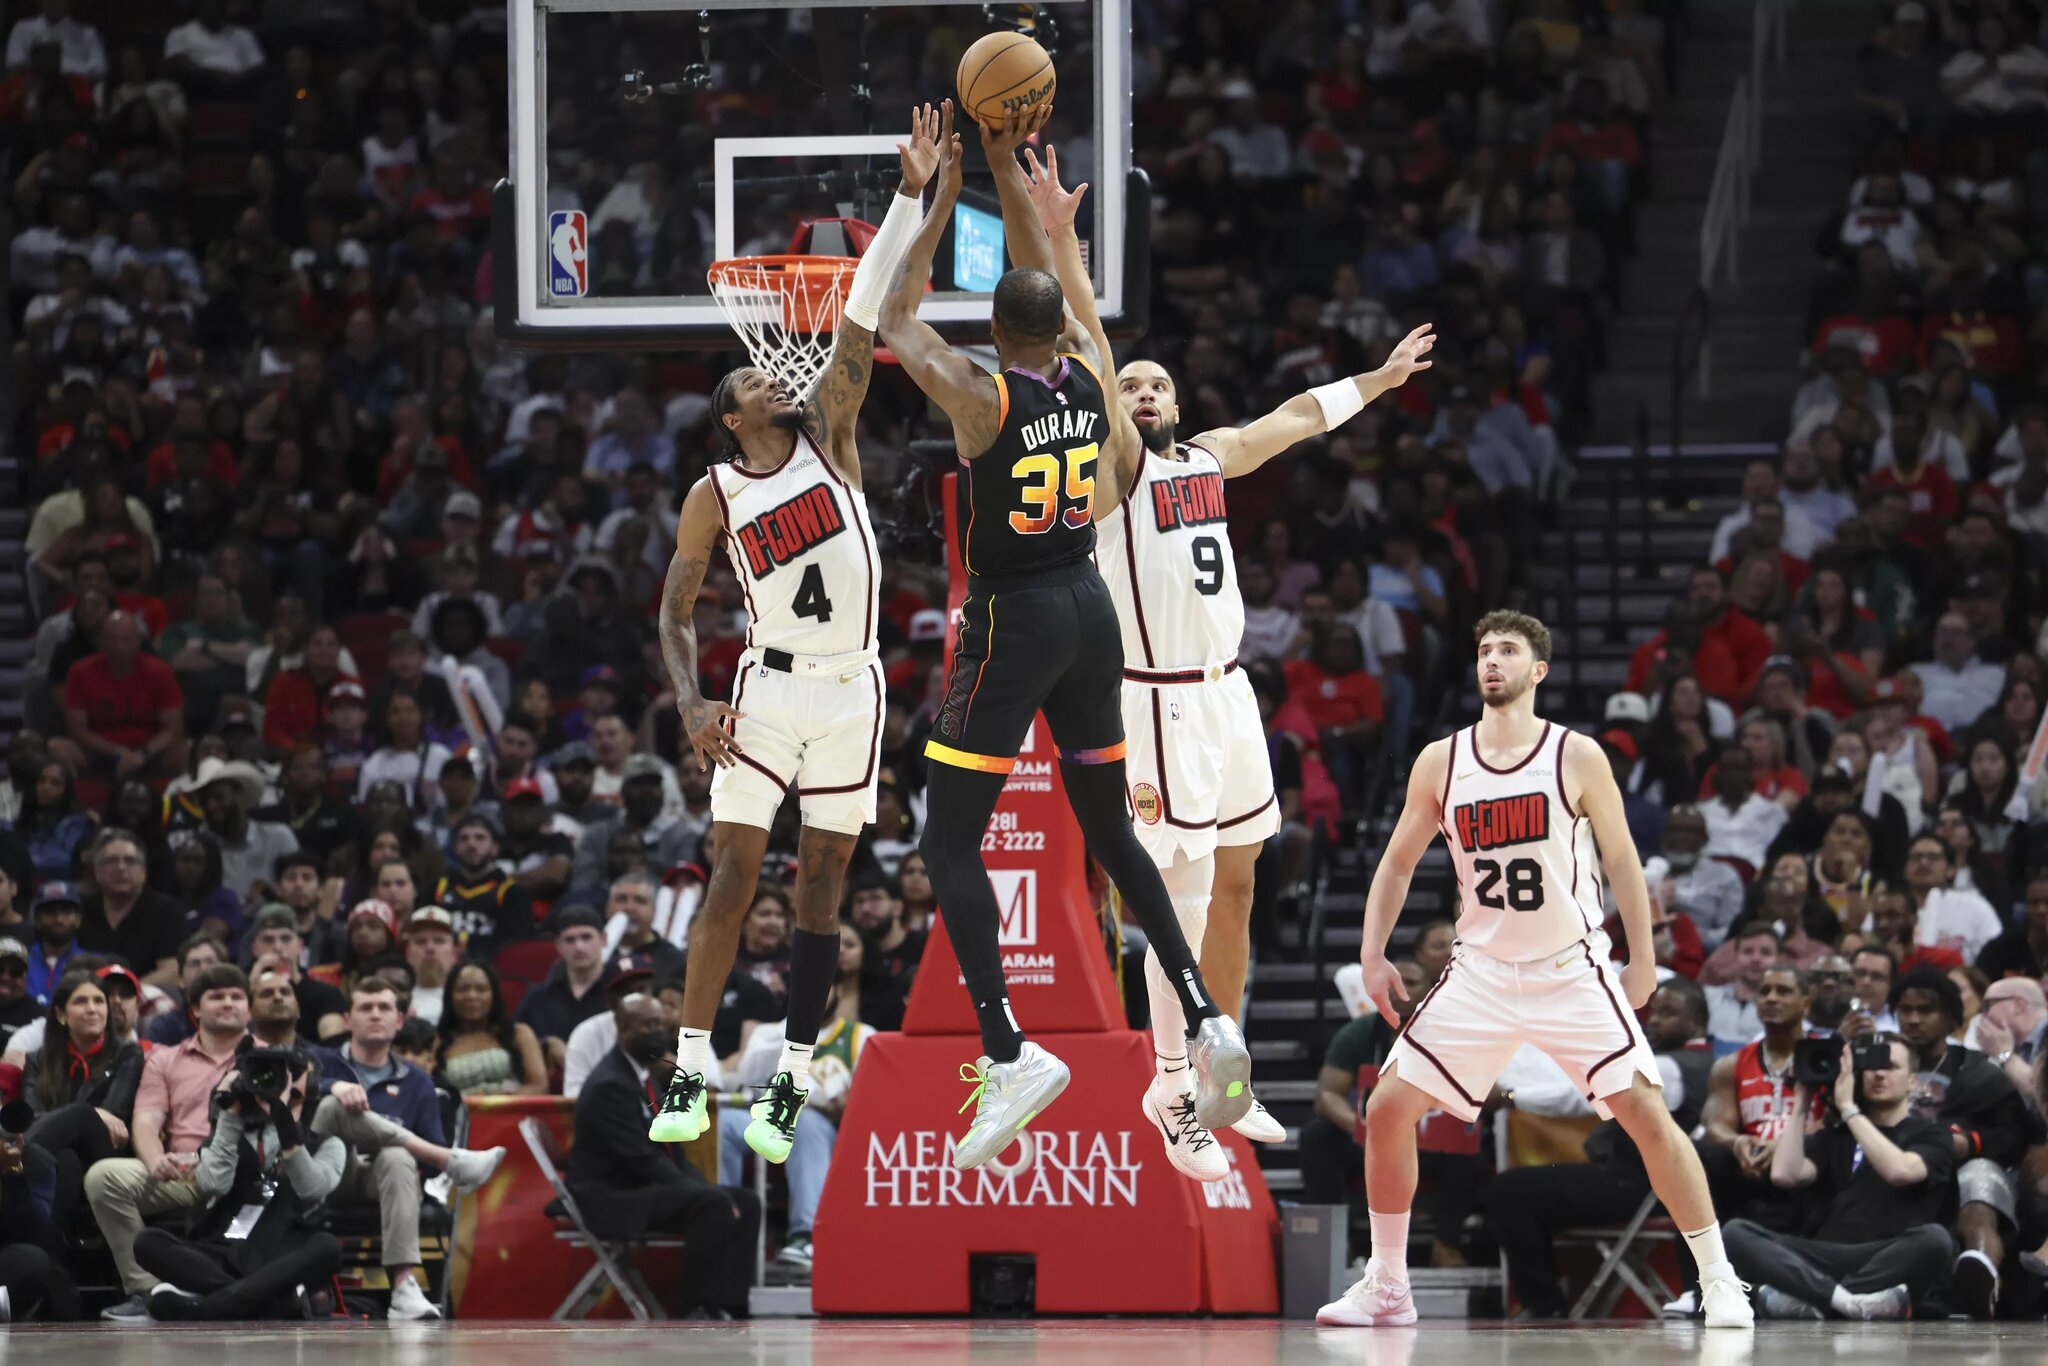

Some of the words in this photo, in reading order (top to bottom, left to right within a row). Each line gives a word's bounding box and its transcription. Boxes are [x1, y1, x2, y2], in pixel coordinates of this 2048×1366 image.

[1001, 77, 1054, 112] Wilson
[555, 278, 574, 292] NBA
[1020, 409, 1099, 452] DURANT
[1008, 441, 1099, 535] 35
[1191, 536, 1224, 595] 9
[791, 562, 833, 624] 4
[1474, 858, 1545, 912] 28
[864, 1167, 1141, 1207] HERMANN
